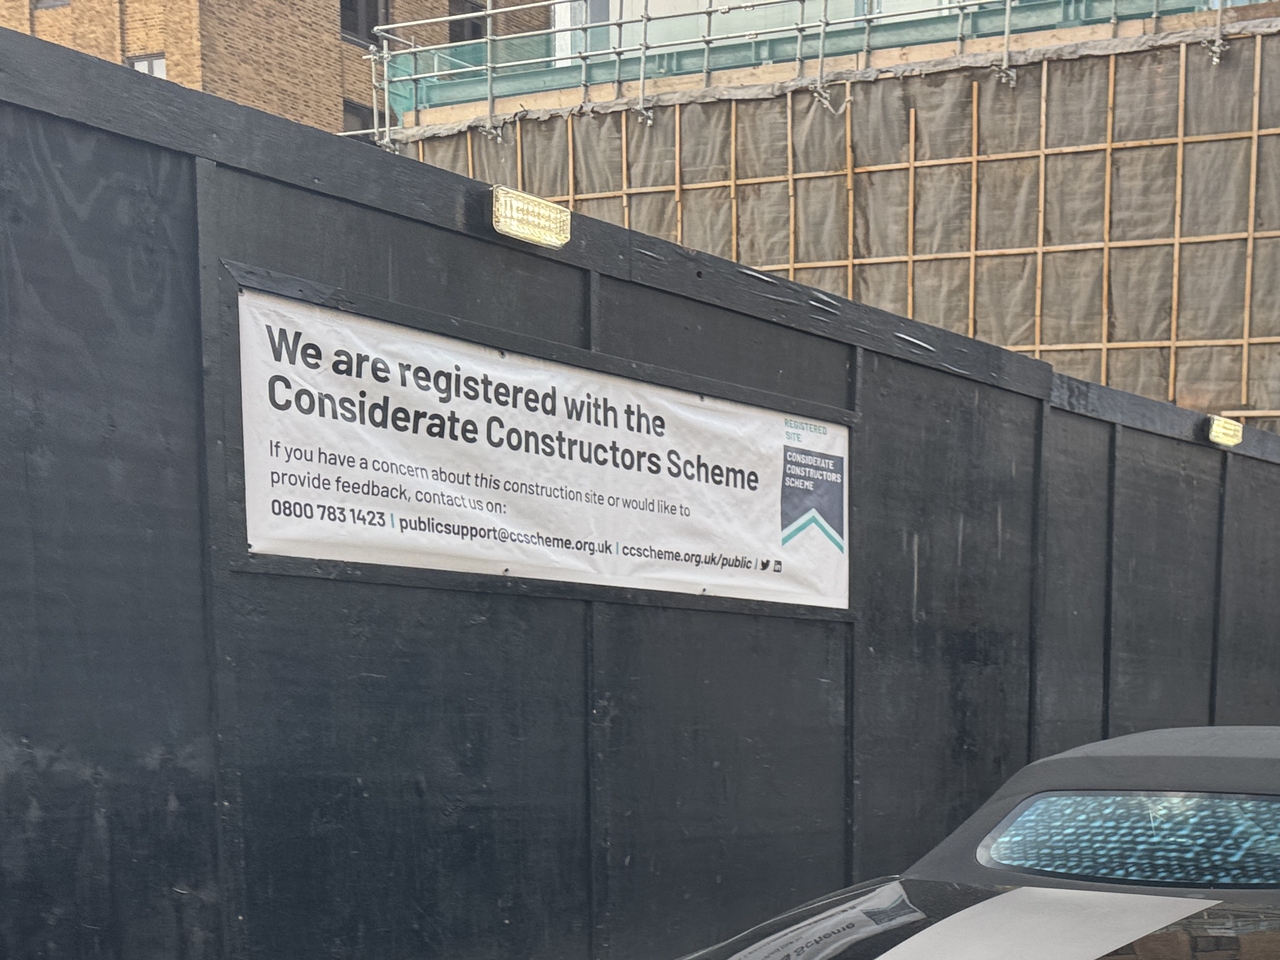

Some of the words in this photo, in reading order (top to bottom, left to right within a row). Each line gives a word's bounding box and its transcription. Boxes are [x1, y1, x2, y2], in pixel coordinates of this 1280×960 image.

[264, 323, 323, 370] We
[331, 348, 391, 384] are
[398, 361, 557, 417] registered
[563, 391, 619, 430] with
[624, 403, 666, 438] the
[267, 374, 479, 444] Considerate
[485, 414, 662, 475] Constructors
[667, 448, 759, 492] Scheme
[784, 418, 828, 435] REGISTERED
[785, 431, 802, 442] SITE
[786, 464, 841, 483] CONSTRUCTORS
[787, 452, 834, 469] CONSIDERATE
[269, 439, 281, 458] If
[283, 445, 314, 463] you
[317, 446, 356, 468] have
[358, 456, 368, 470] a
[371, 458, 429, 480] concern
[430, 466, 472, 486] about
[473, 471, 501, 490] this
[502, 479, 583, 502] construction
[584, 489, 605, 506] site
[606, 495, 623, 509] or
[623, 497, 656, 512] would
[656, 499, 677, 515] like
[678, 503, 691, 517] to
[270, 470, 331, 491] provide
[334, 475, 411, 503] feedback,
[414, 489, 469, 509] contact
[469, 498, 484, 511] us
[485, 500, 506, 515] on:
[785, 477, 814, 490] SCHEME
[270, 498, 314, 520] 0800
[316, 503, 347, 523] 783
[348, 507, 386, 528] 1423
[398, 515, 613, 555] publicsupport@ccscheme.org.uk
[621, 544, 752, 570] ccscheme.org.uk/public
